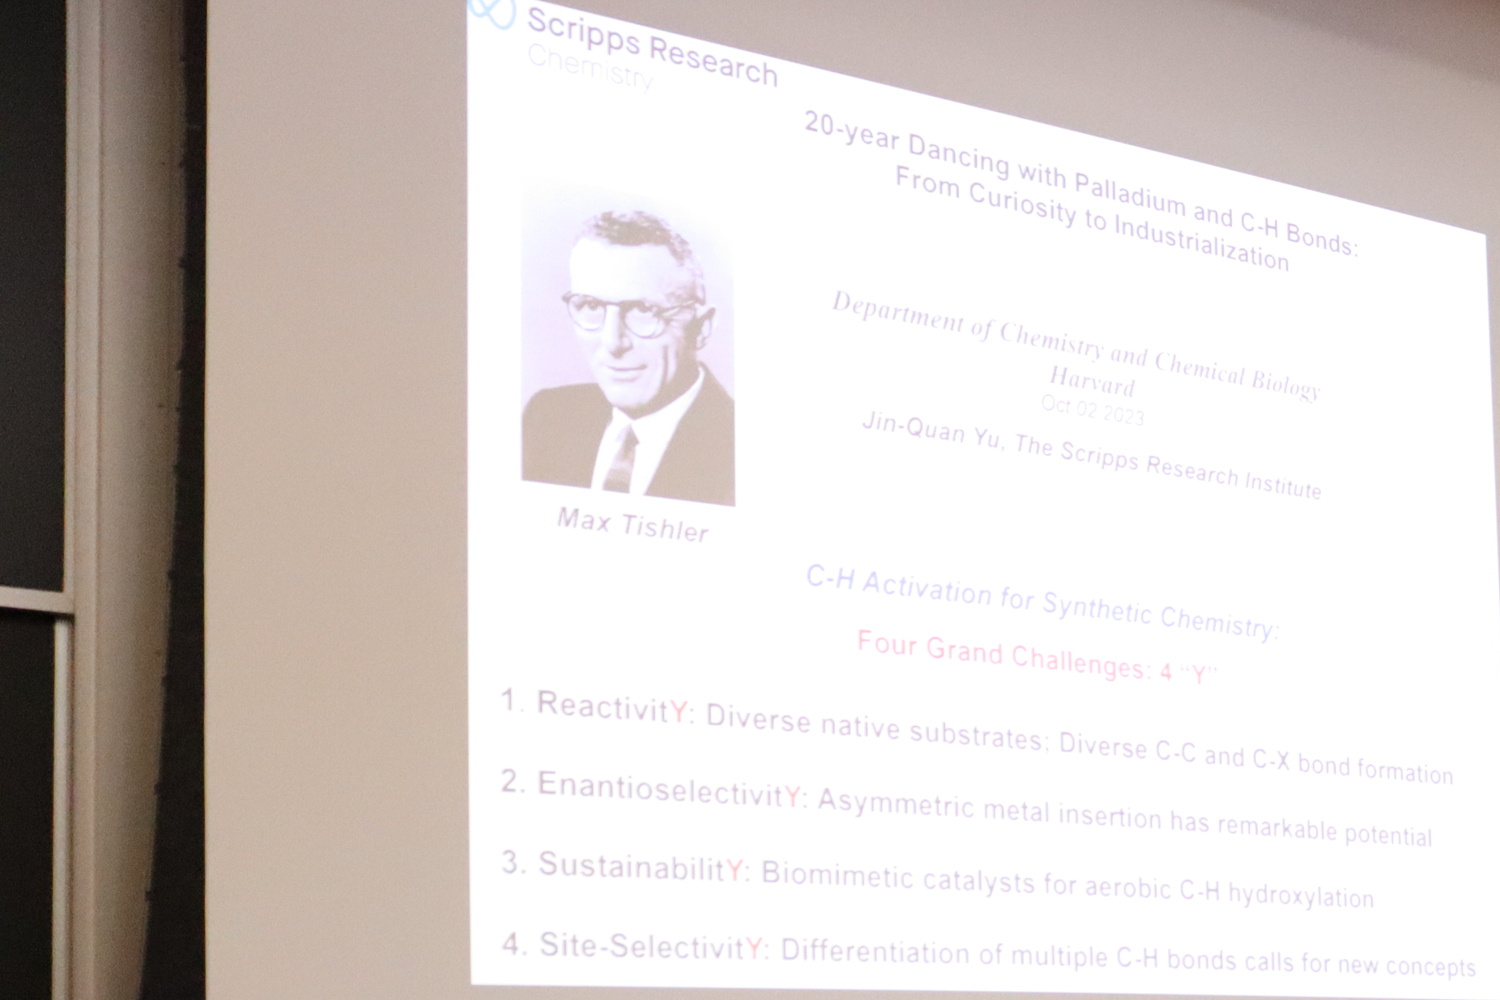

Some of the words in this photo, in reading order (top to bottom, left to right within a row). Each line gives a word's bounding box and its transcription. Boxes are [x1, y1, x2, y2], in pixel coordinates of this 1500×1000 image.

[527, 6, 641, 56] Scripps
[649, 35, 778, 88] Research
[528, 43, 654, 94] Chemistry
[804, 109, 900, 150] 20-year
[908, 133, 1010, 182] Dancing
[1017, 163, 1067, 189] with
[1075, 172, 1186, 217] Palladium
[1193, 205, 1233, 228] and
[1241, 212, 1278, 238] C-H
[1286, 222, 1358, 257] Bonds:
[896, 164, 960, 199] From
[969, 181, 1077, 229] Curiosity
[1084, 209, 1107, 231] to
[1115, 214, 1289, 272] Industrialization
[832, 290, 964, 333] Department
[971, 320, 996, 343] of
[1000, 320, 1104, 363] Chemistry
[1110, 348, 1148, 367] and
[1155, 352, 1245, 385] Chemical
[1252, 370, 1321, 404] Biology
[1050, 365, 1136, 398] Harvard
[1042, 394, 1071, 413] Oct
[1077, 400, 1097, 418] 02
[1104, 405, 1144, 426] 2023
[862, 411, 965, 443] Jin-Quan
[974, 427, 1005, 452] Yu,
[1016, 433, 1053, 457] The
[1061, 441, 1138, 472] Scripps
[1146, 455, 1239, 486] Research
[1245, 472, 1322, 500] Institute
[557, 506, 612, 532] Max
[622, 513, 710, 543] Tishler
[806, 563, 855, 590] C-H
[862, 571, 992, 605] Activation
[1001, 586, 1035, 610] for
[1043, 591, 1152, 625] Synthetic
[1161, 606, 1279, 644] Chemistry:
[858, 629, 918, 656] Four
[926, 636, 1003, 665] Grand
[1012, 645, 1151, 682] Challenges:
[1160, 662, 1172, 681] 4
[501, 687, 524, 712] 1.
[537, 689, 694, 724] ReactivitY:
[707, 702, 811, 734] Diverse
[821, 715, 900, 740] native
[910, 721, 1049, 752] substrates;
[1060, 731, 1147, 760] Diverse
[1156, 739, 1196, 763] C-C
[1205, 747, 1245, 767] and
[1253, 748, 1290, 771] C-X
[1298, 752, 1350, 776] bond
[1357, 758, 1453, 785] formation
[500, 768, 525, 794] 2.
[538, 770, 807, 809] EnantioselectivitY:
[817, 787, 974, 818] Asymmetric
[984, 801, 1049, 822] metal
[1059, 803, 1162, 829] insertion
[1170, 810, 1210, 833] has
[1218, 818, 1337, 841] remarkable
[1345, 826, 1432, 847] potential
[501, 849, 527, 875] 3.
[539, 850, 750, 882] SustainabilitY:
[762, 859, 913, 889] Biomimetic
[923, 869, 1035, 898] catalysts
[1044, 872, 1077, 895] for
[1085, 877, 1171, 900] aerobic
[1180, 879, 1220, 901] C-H
[1229, 882, 1374, 911] hydroxylation
[501, 931, 527, 956] 4.
[540, 931, 769, 960] Site-SelectivitY:
[781, 937, 969, 964] Differentiation
[979, 942, 1003, 965] of
[1012, 945, 1108, 972] multiple
[1117, 946, 1158, 968] C-H
[1167, 948, 1237, 971] bonds
[1245, 951, 1294, 972] calls
[1301, 952, 1331, 973] for
[1338, 958, 1379, 974] new
[1386, 959, 1476, 981] concepts
